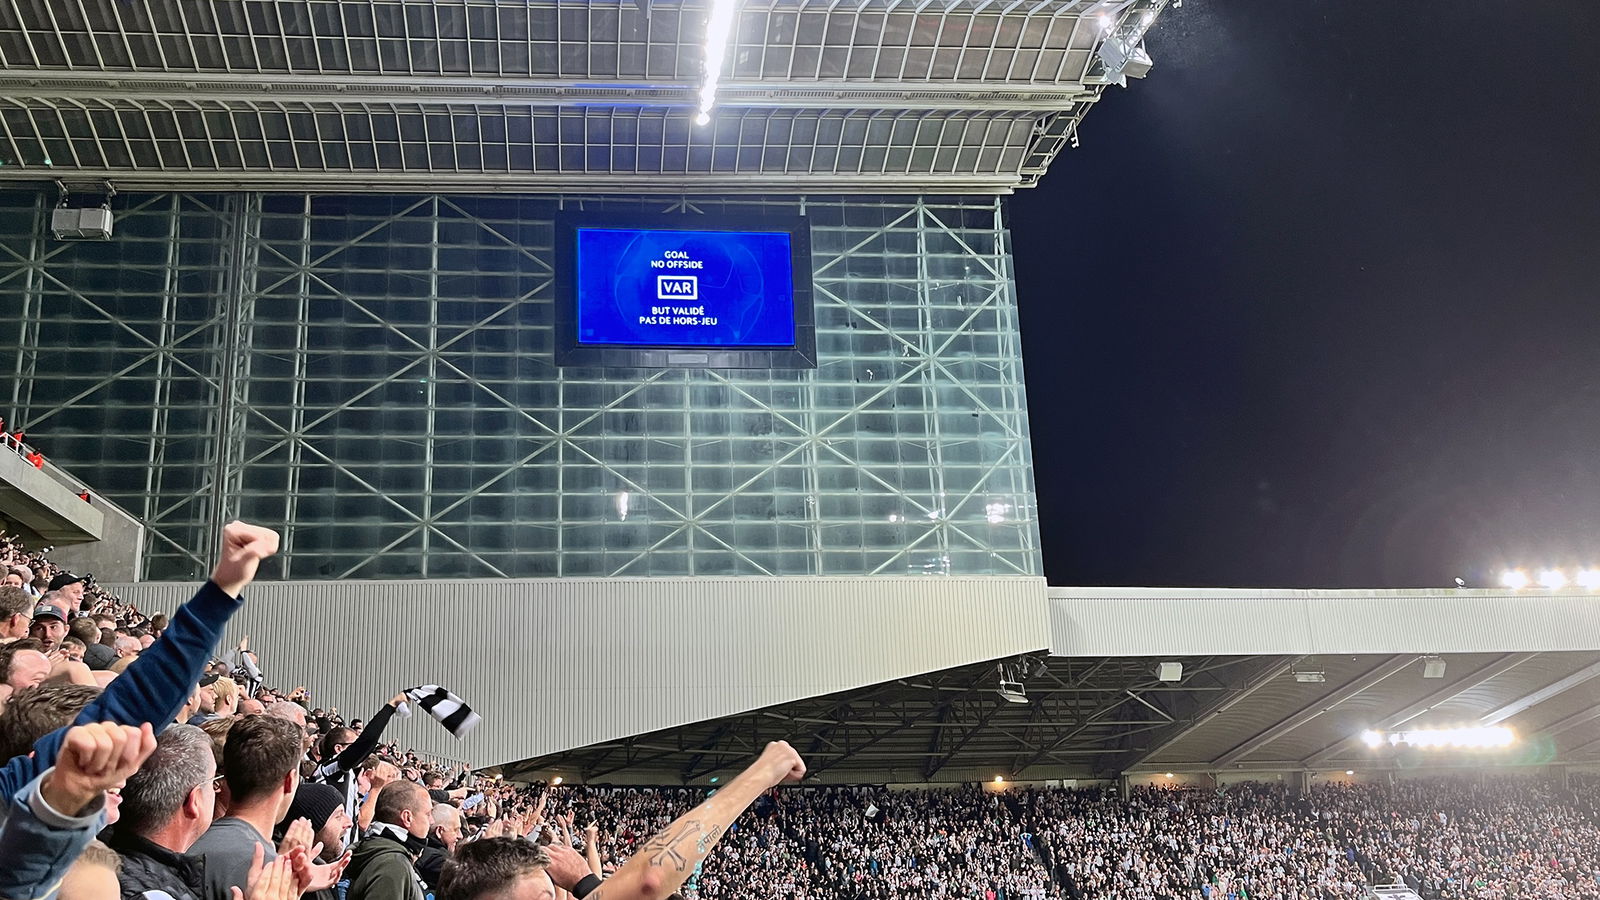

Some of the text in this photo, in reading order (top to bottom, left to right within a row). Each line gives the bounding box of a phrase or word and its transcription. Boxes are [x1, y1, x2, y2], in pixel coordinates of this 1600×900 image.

[664, 250, 690, 259] GOAL
[650, 260, 704, 269] NO OFFSIDE
[663, 281, 692, 294] VAR
[651, 305, 705, 316] BUT VALIDÉ
[639, 316, 718, 326] PAS DE HORS-JEU
